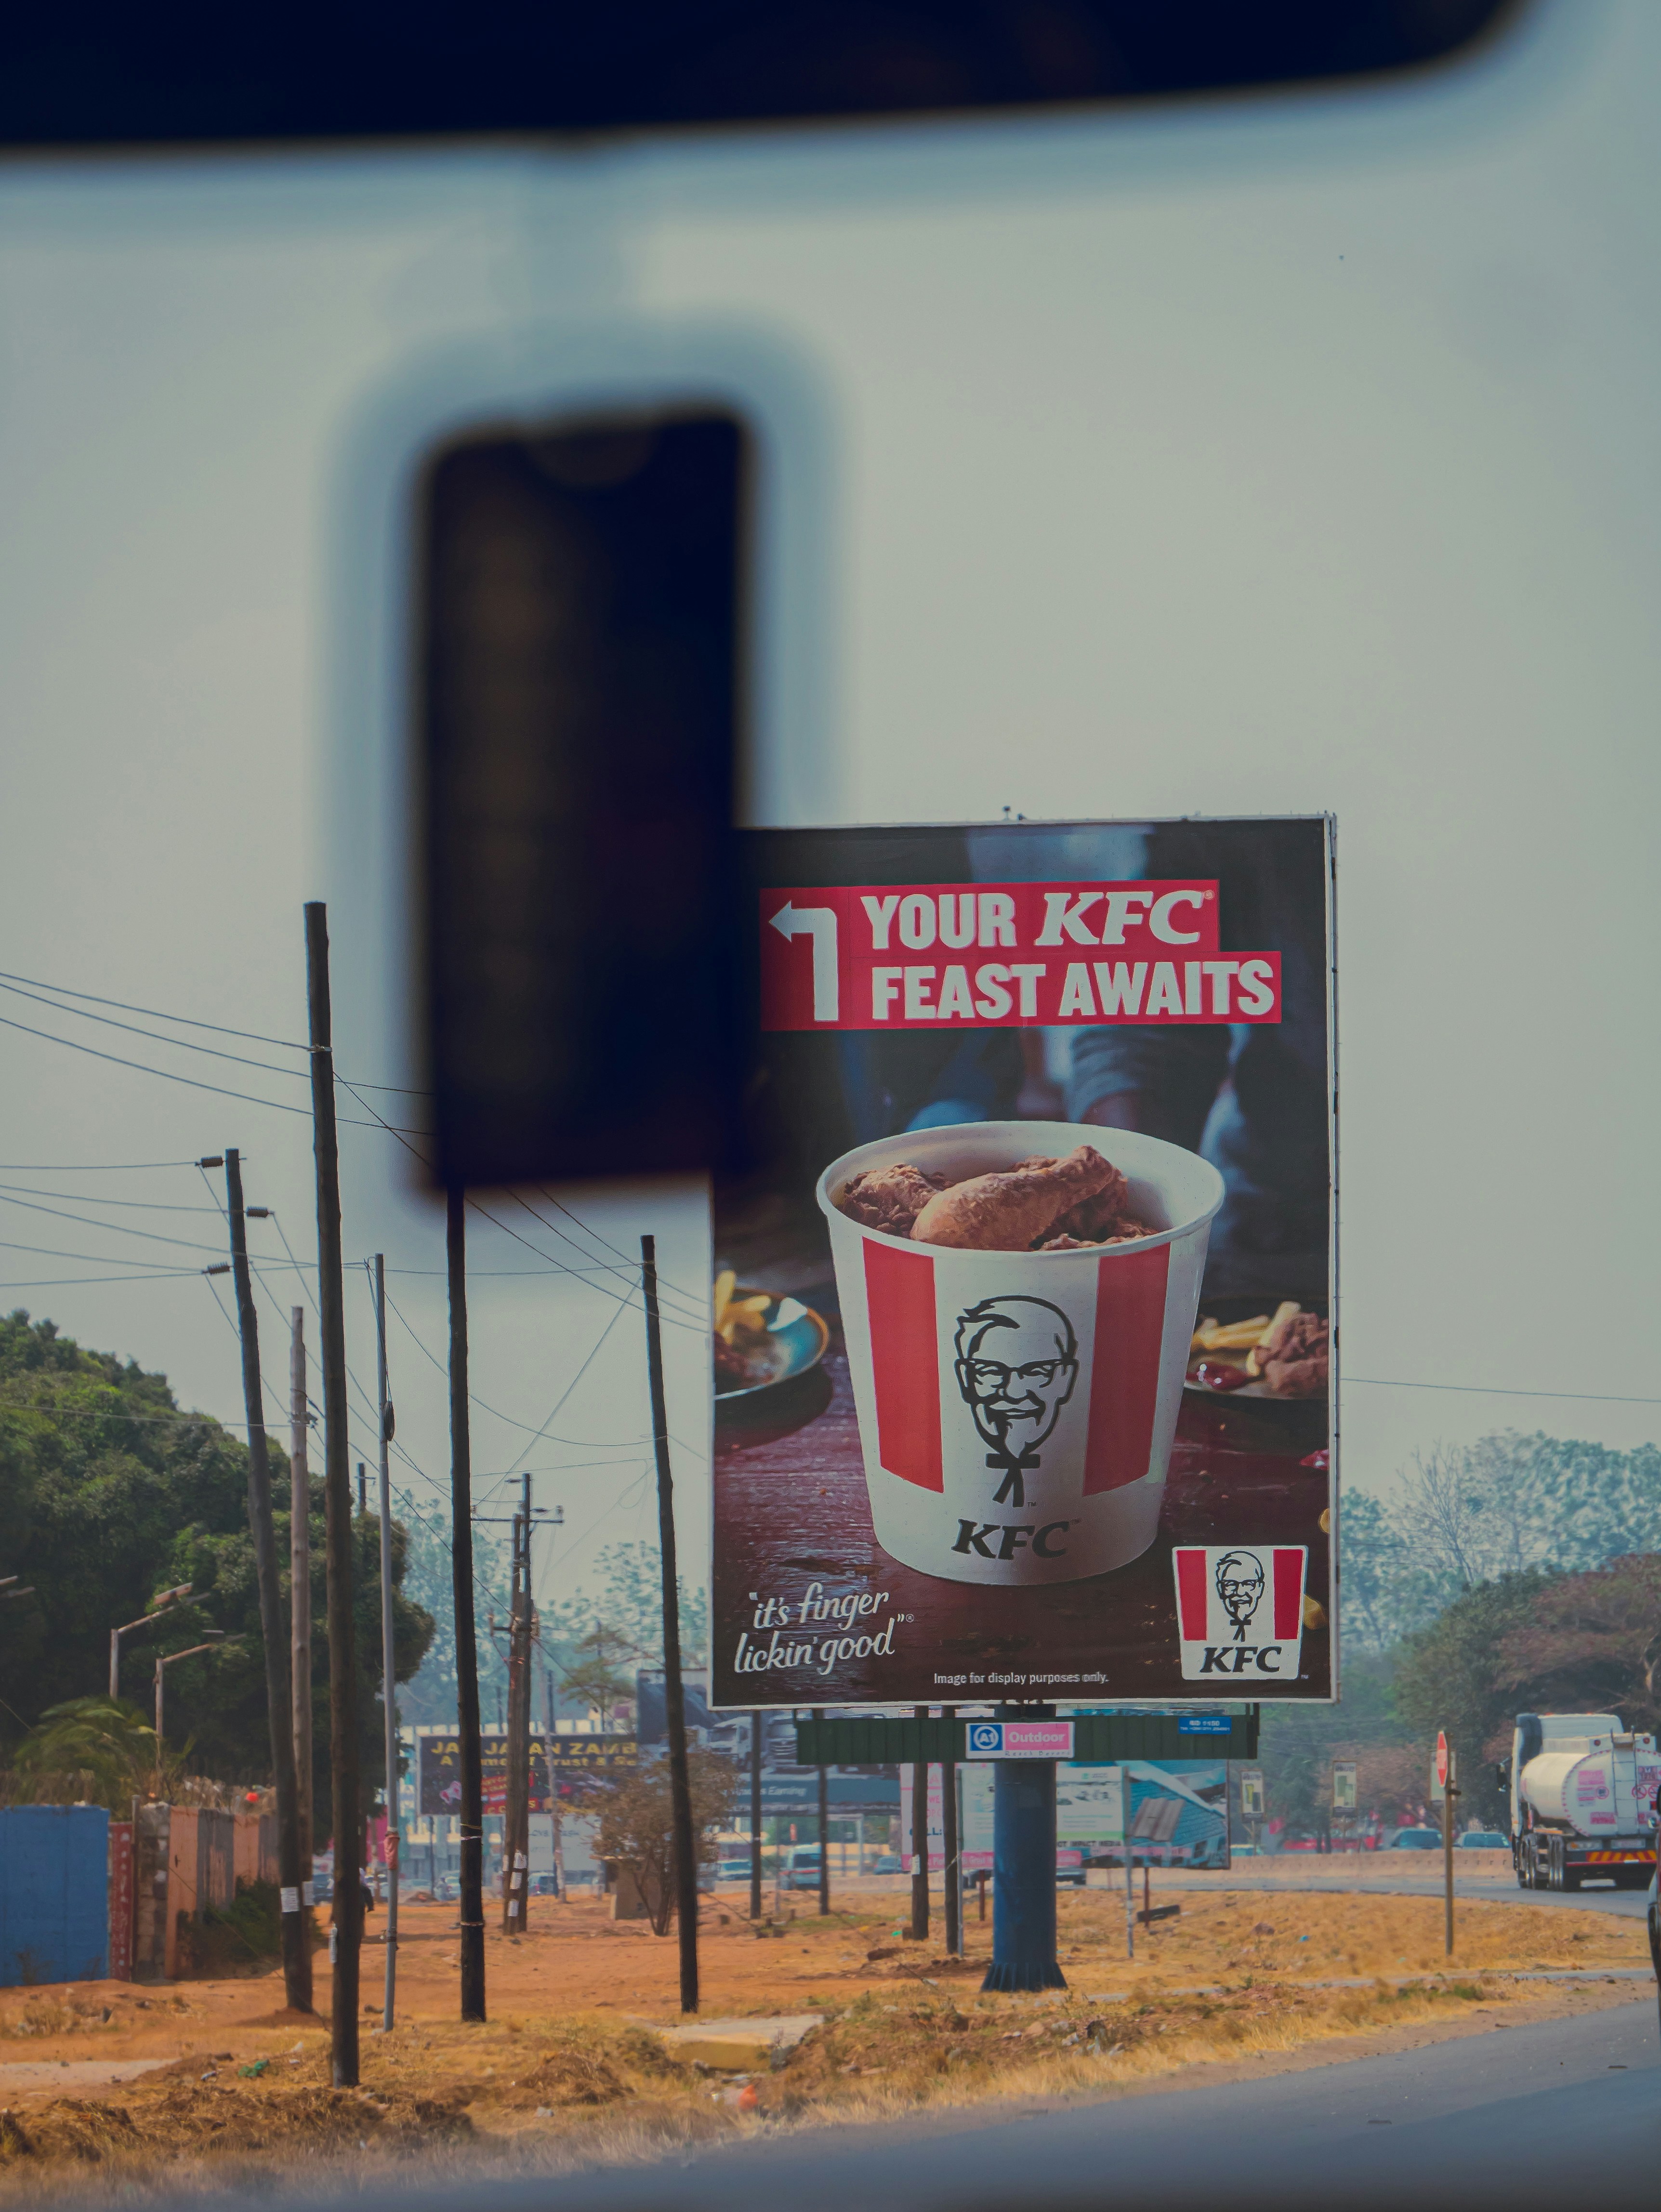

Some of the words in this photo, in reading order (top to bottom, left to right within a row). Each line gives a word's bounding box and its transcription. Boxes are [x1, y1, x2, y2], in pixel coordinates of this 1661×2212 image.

[860, 893, 1017, 950] YOUR
[872, 963, 1046, 1020] FEAST
[1058, 960, 1275, 1016] AWAITS
[951, 1519, 1070, 1561] KFC
[797, 1582, 889, 1630] finger
[1200, 1646, 1282, 1672] KFC
[934, 1673, 967, 1685] Image
[969, 1672, 986, 1683] for
[988, 1672, 1026, 1685] display
[1029, 1674, 1080, 1685] purposes
[979, 1732, 997, 1743] A1
[1009, 1731, 1065, 1743] Outdoor
[484, 1742, 561, 1755] JAAN
[440, 1755, 453, 1766] A
